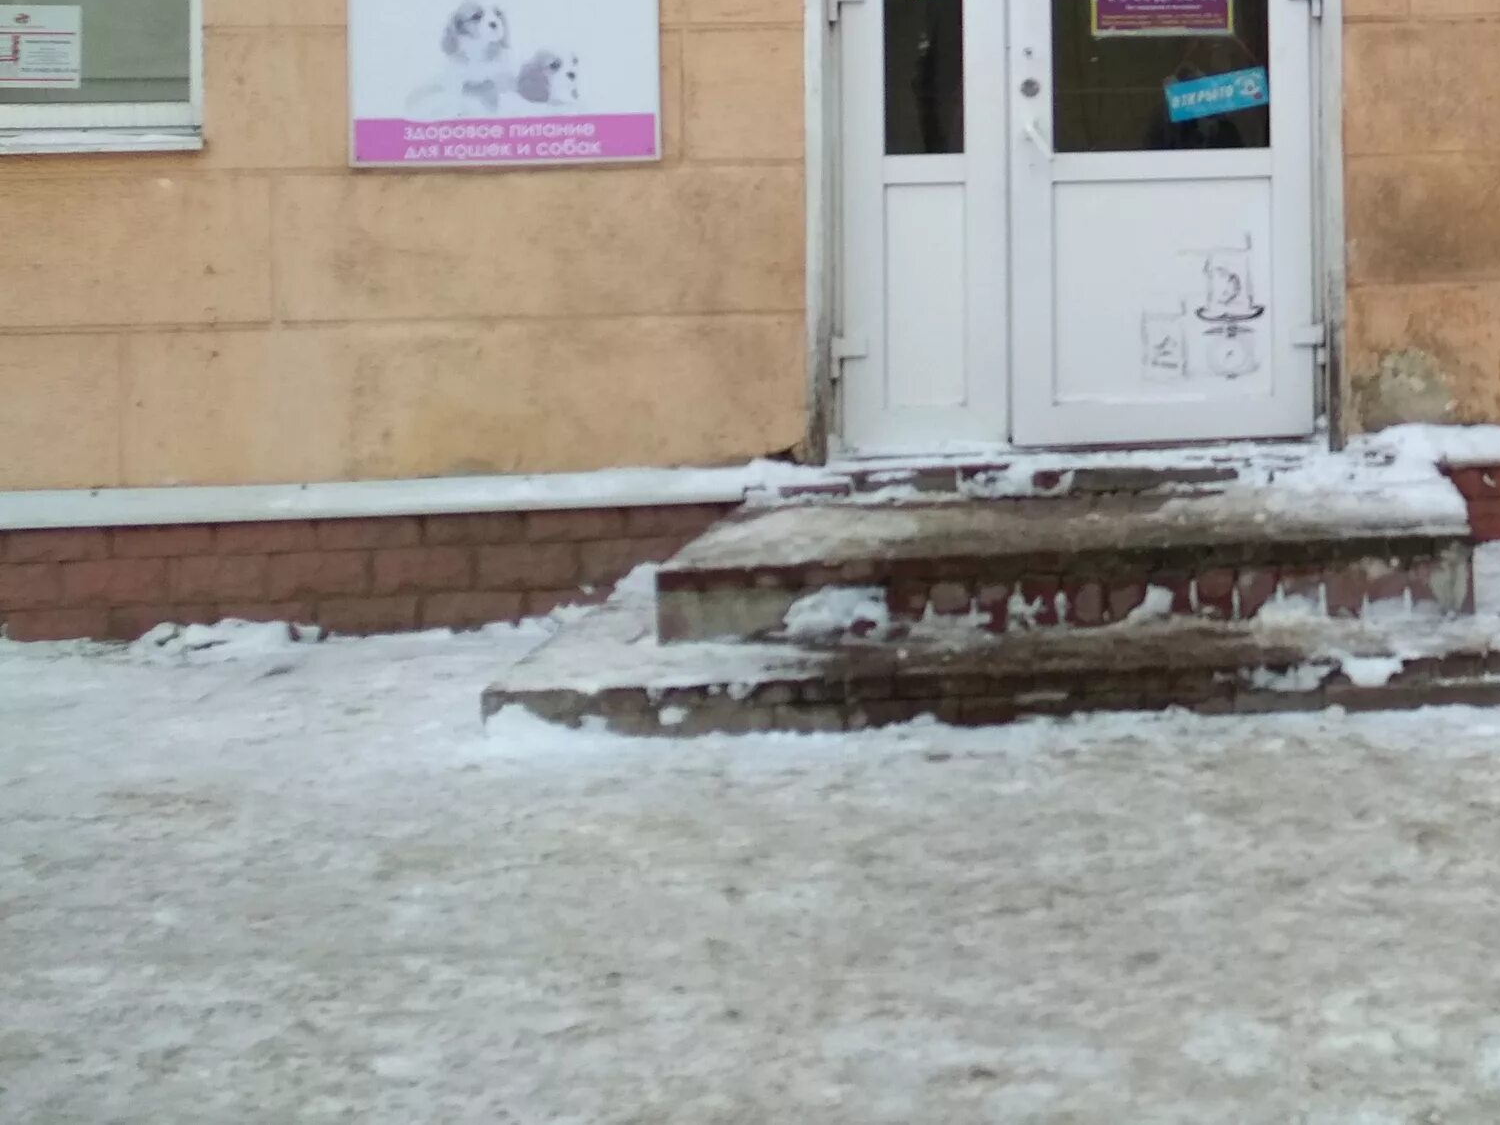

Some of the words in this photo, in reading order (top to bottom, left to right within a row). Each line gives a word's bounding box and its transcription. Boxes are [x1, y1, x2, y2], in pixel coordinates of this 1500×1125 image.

[404, 144, 438, 160] для
[443, 143, 512, 160] кошек
[516, 142, 531, 156] и
[535, 138, 602, 156] собак
